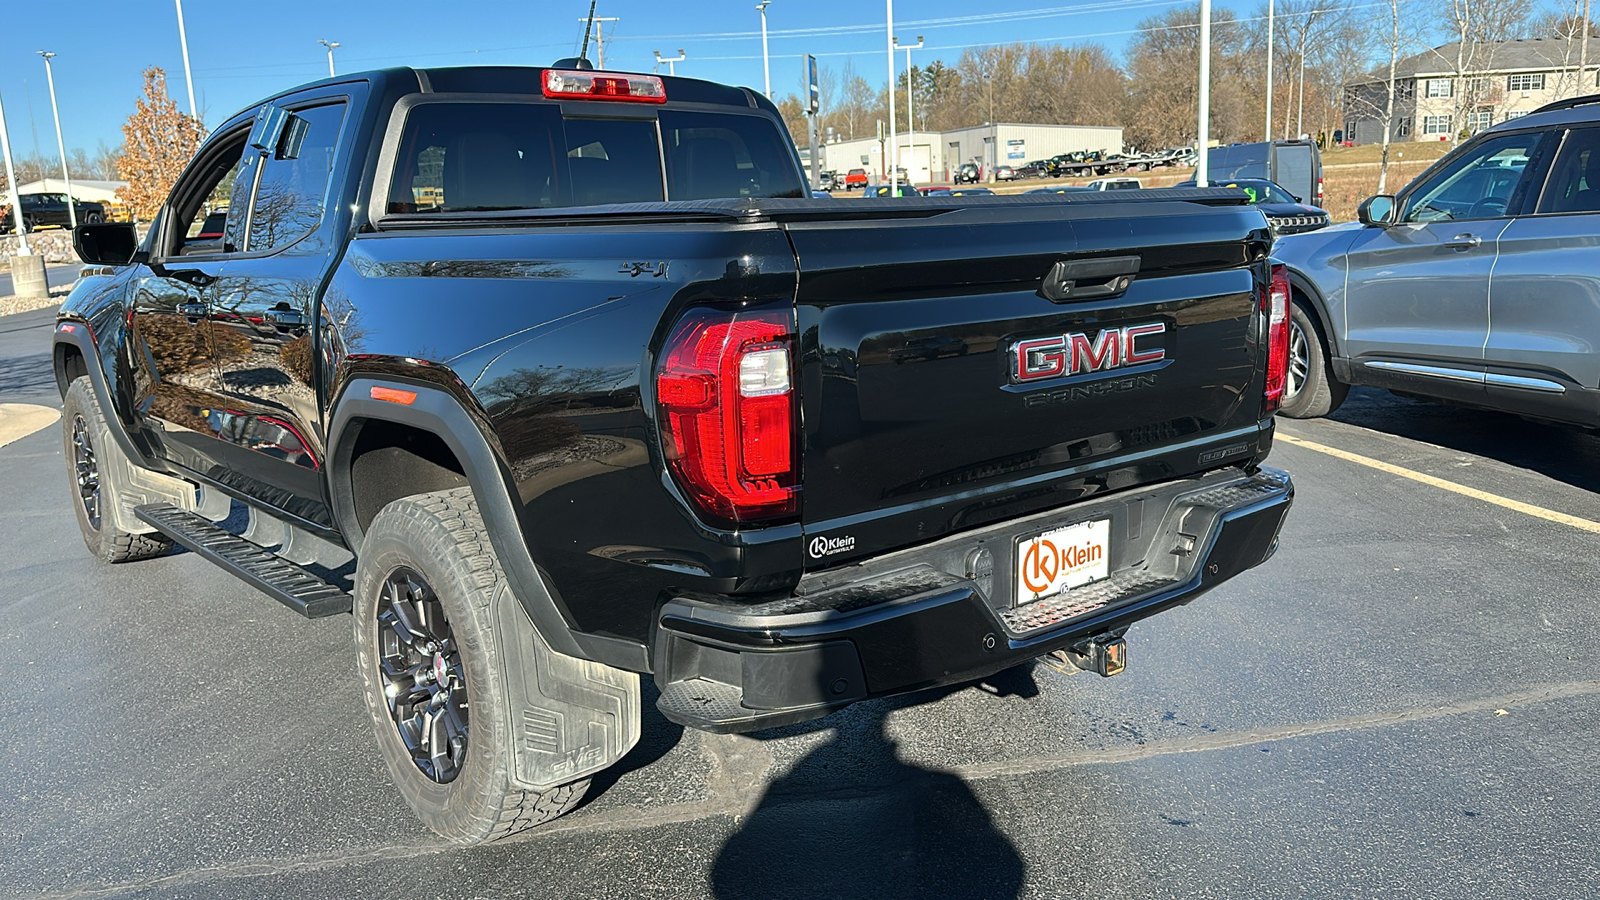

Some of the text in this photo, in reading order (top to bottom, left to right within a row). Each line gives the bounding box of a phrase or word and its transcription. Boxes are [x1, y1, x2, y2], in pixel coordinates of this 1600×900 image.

[1010, 322, 1166, 384] GMC
[1023, 373, 1158, 408] CANYON
[828, 535, 855, 550] Klein
[1061, 540, 1102, 571] Klein
